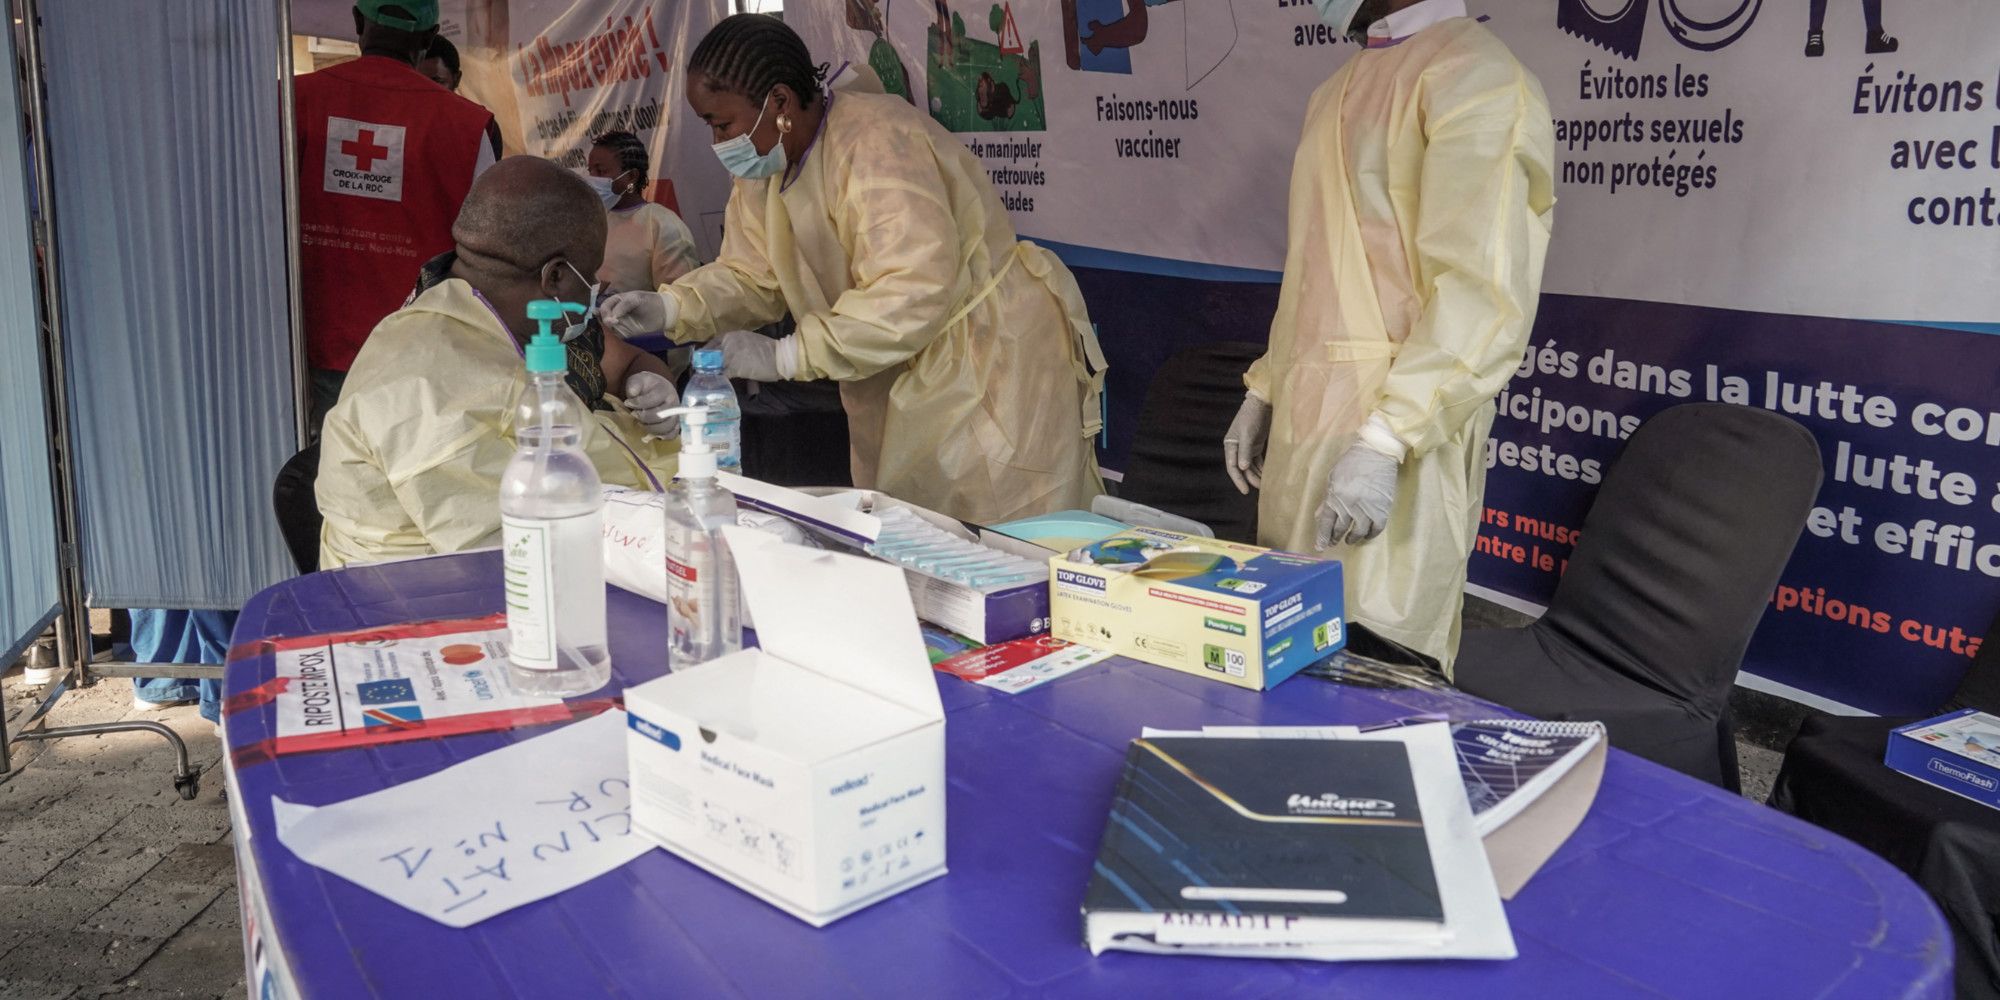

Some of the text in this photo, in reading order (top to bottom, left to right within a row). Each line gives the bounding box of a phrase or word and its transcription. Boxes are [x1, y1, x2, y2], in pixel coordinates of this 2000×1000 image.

[1579, 59, 1709, 100] Évitons les
[1853, 62, 1984, 115] Évitons
[1097, 94, 1198, 121] Faisons-nous
[1552, 108, 1744, 151] apports sexuels
[986, 137, 1042, 164] manipuler
[1115, 131, 1181, 160] vacciner
[1890, 138, 1978, 170] avec
[333, 169, 392, 184] CROIX-ROUGE
[339, 180, 384, 193] DE LA RDC
[992, 162, 1045, 186] retrouvés
[1562, 149, 1717, 197] non protégés
[1906, 187, 2000, 227] cont
[1588, 348, 1692, 398] dans
[1706, 363, 1750, 405] la
[1766, 371, 1898, 429] lutte
[1495, 382, 1641, 440] icipons
[1834, 440, 1977, 506] lutte
[1806, 506, 1863, 545] et
[1532, 545, 1555, 572] le
[1058, 571, 1106, 589] TOP GLOVE
[1264, 592, 1303, 618] TOP GLOVE
[1769, 584, 1892, 634] ptions
[1211, 651, 1244, 666] M 100
[299, 649, 334, 727] RIPOSTE MPOX
[1932, 760, 1994, 790] ThermoFlash
